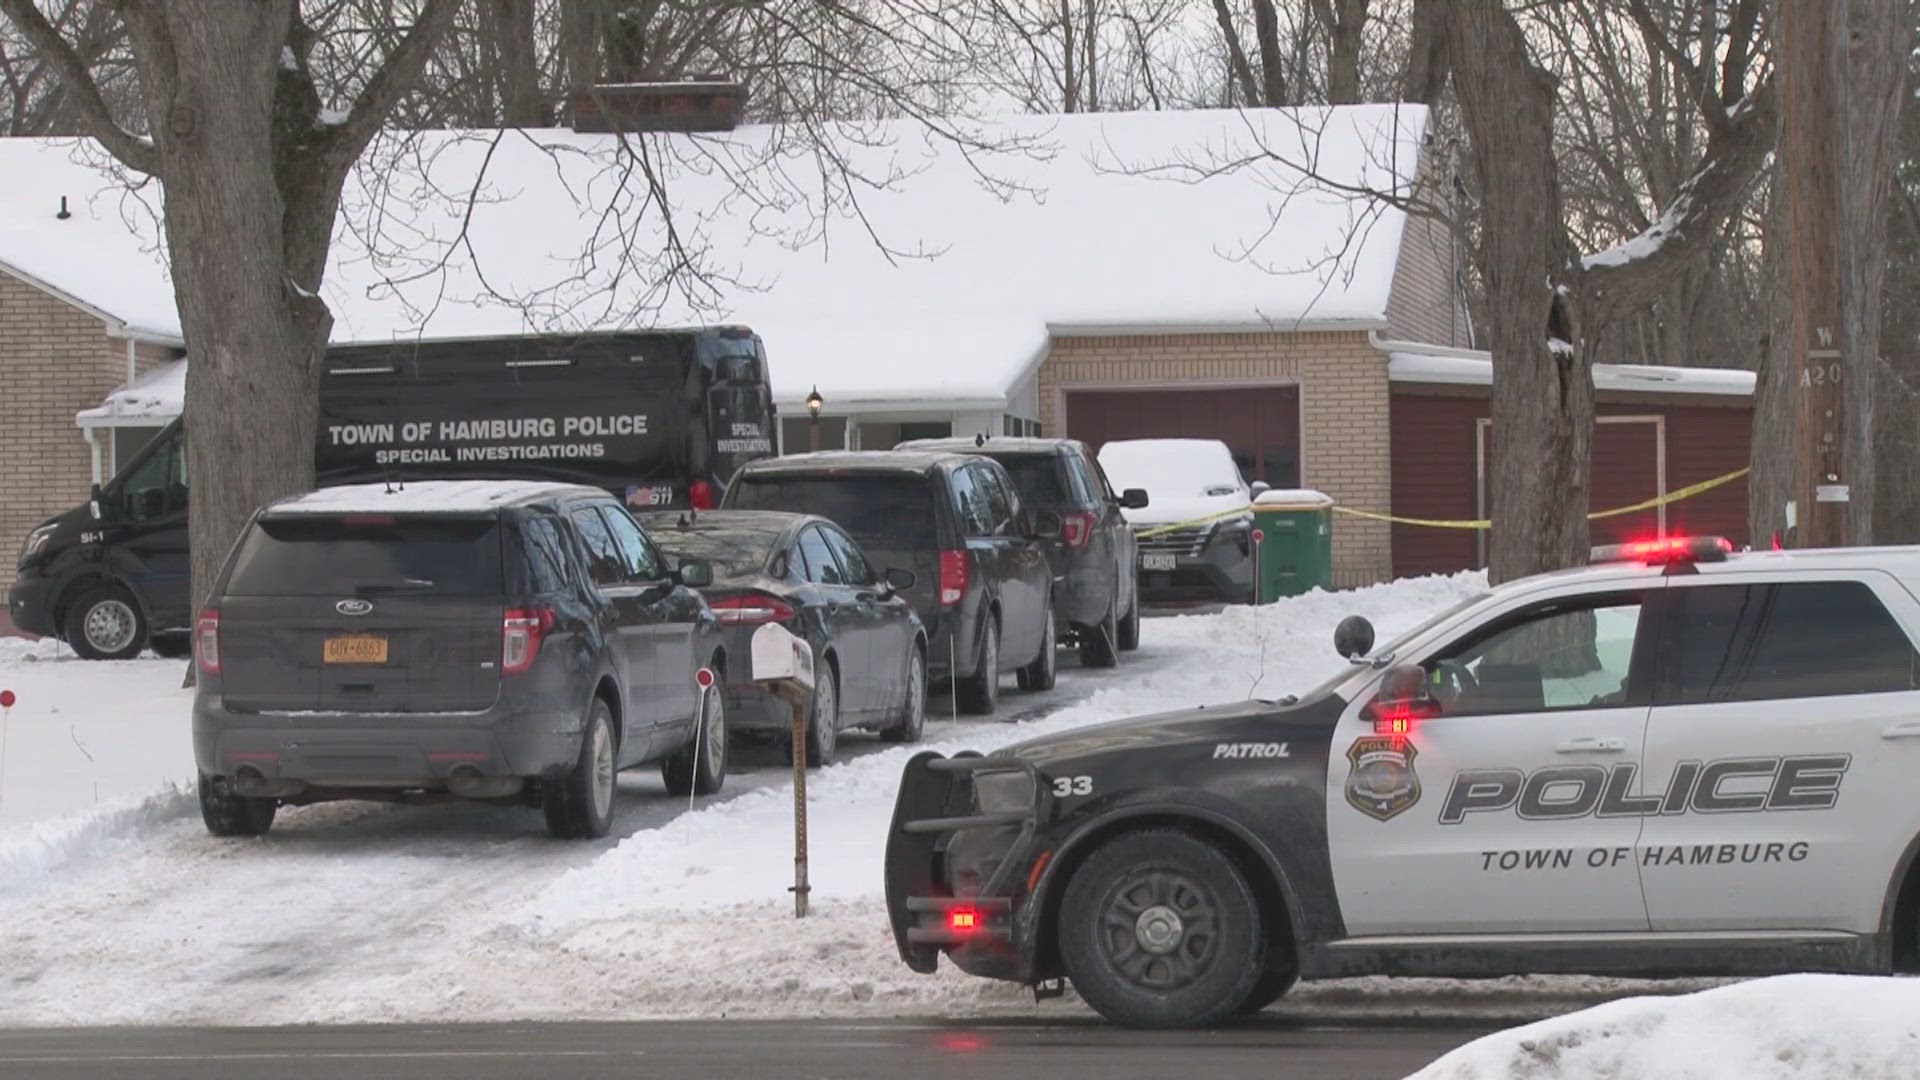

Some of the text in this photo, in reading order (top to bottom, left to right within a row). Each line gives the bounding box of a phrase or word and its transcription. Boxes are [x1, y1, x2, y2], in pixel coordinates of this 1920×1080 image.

[329, 415, 648, 445] TOWN OF HAMBURG POLICE
[731, 423, 760, 436] SPECIAL
[376, 443, 605, 463] SPECIAL INVESTIGATIONS
[650, 493, 673, 505] 911
[1212, 743, 1289, 759] PATROL
[1053, 776, 1093, 797] 33
[1439, 753, 1852, 825] POLICE
[1482, 841, 1809, 871] TOWN OF HAMBURG
